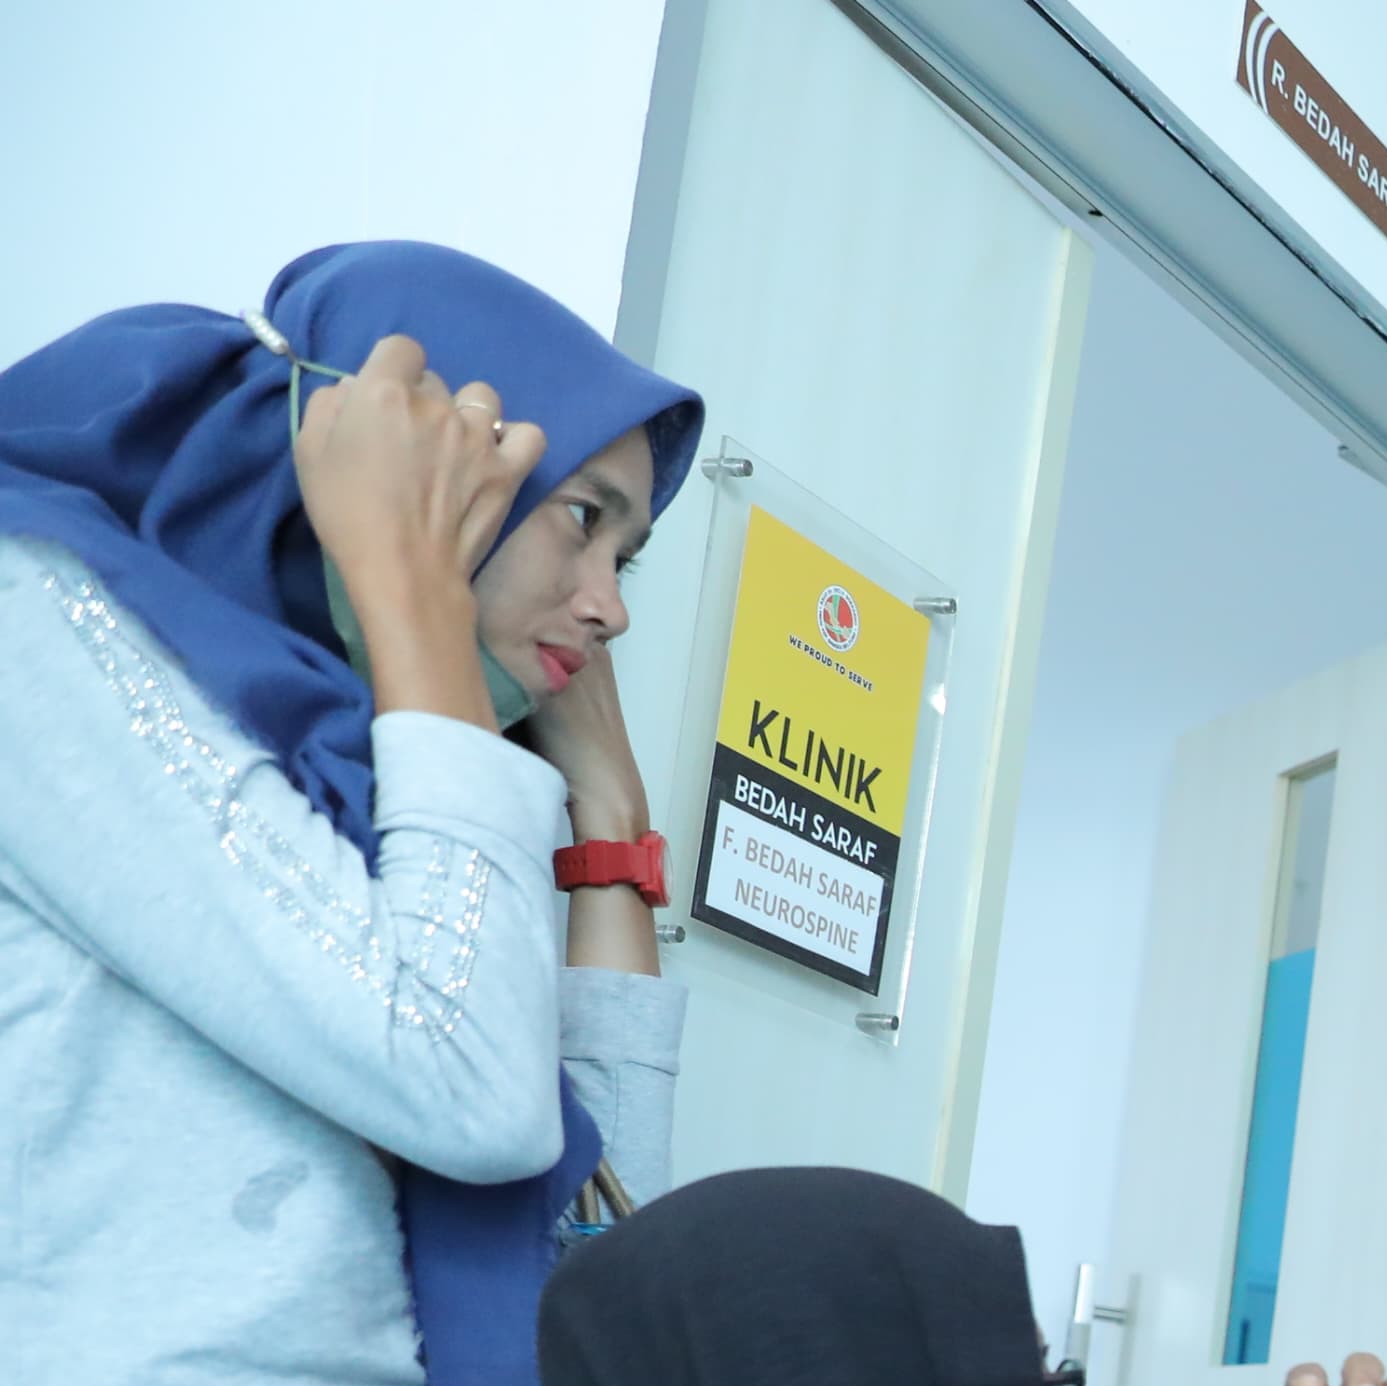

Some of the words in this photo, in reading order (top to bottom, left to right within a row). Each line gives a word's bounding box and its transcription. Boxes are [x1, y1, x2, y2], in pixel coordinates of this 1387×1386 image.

[1271, 58, 1289, 99] R.
[1294, 84, 1354, 168] BEDAH
[789, 634, 802, 649] WE
[804, 644, 832, 667] PROUD
[835, 662, 846, 675] TO
[848, 671, 873, 692] SERVE
[748, 700, 882, 814] KLINIK
[735, 774, 806, 832] BEDAH
[811, 814, 877, 864] SARAF
[722, 826, 738, 855] F.
[745, 837, 813, 889] BEDAH
[817, 872, 877, 917] SARAF
[735, 878, 859, 954] NEUROSPINE
